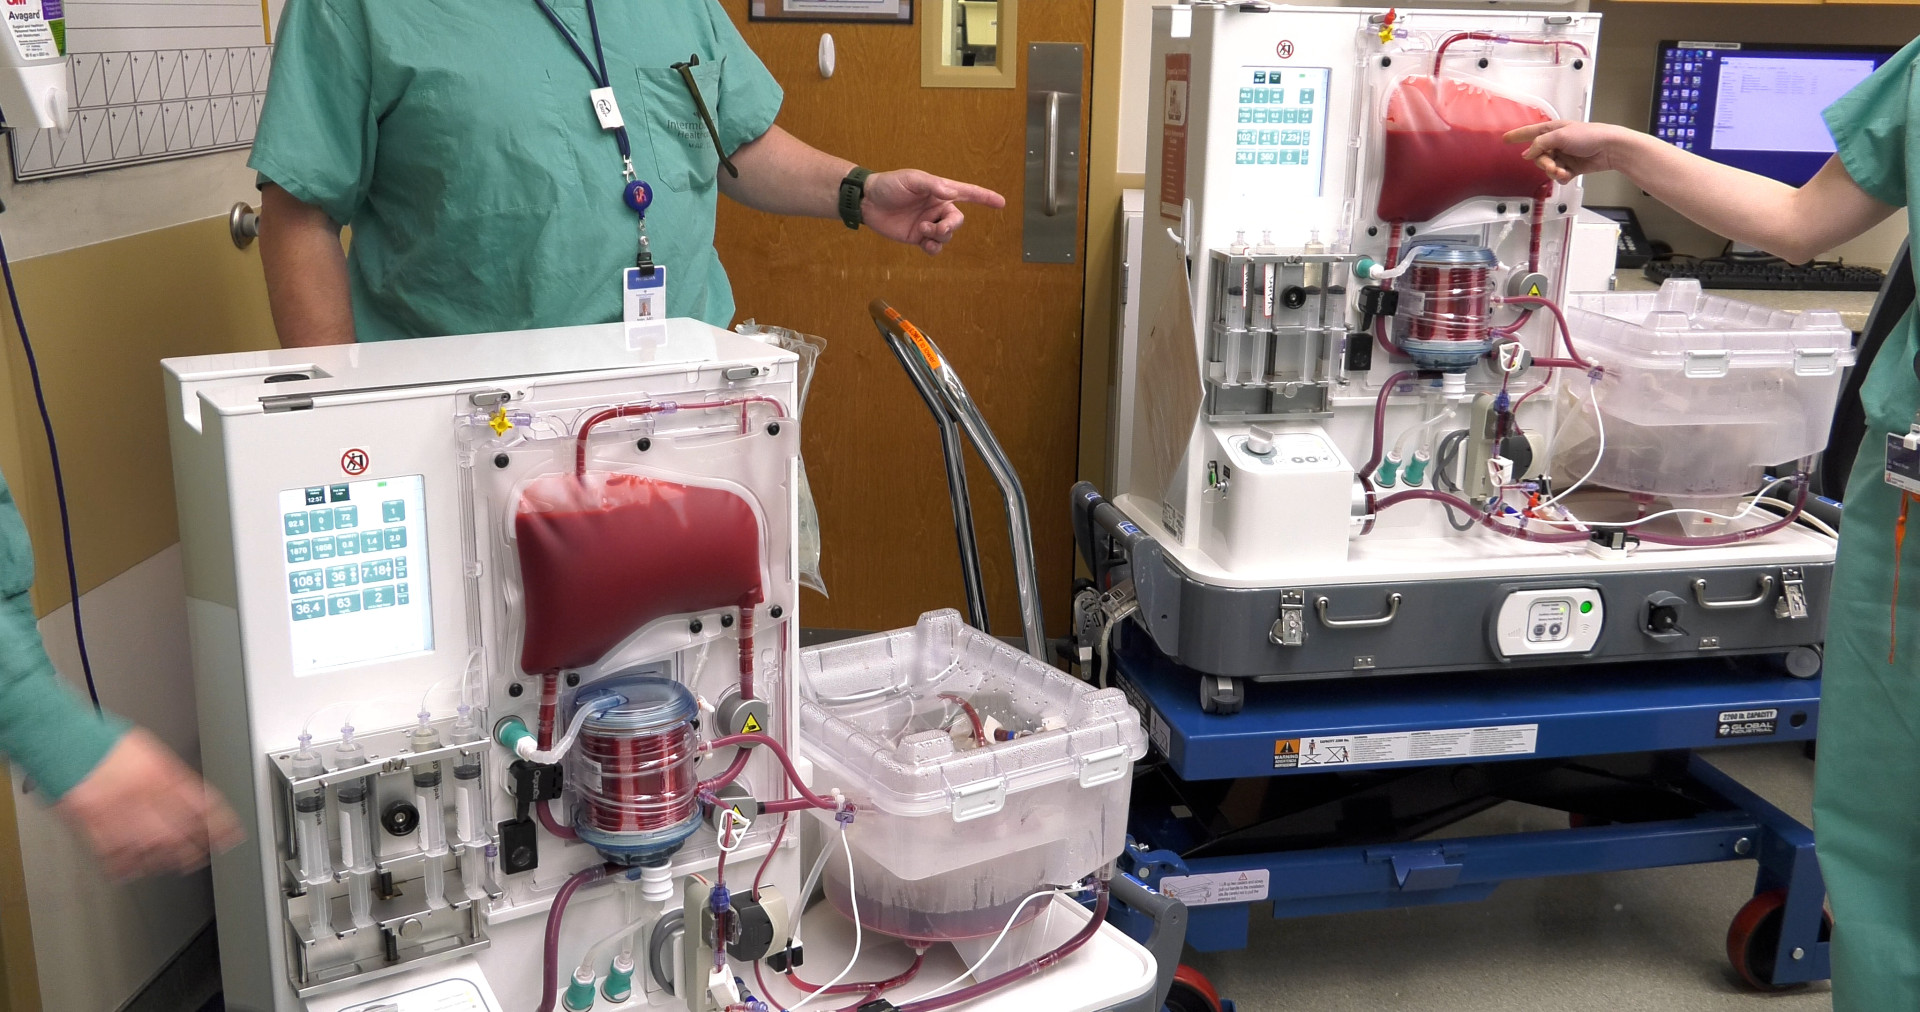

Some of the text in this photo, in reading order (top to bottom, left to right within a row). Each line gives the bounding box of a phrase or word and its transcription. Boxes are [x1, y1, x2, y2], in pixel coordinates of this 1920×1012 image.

[9, 11, 40, 21] Avagard
[293, 574, 313, 587] 108
[331, 570, 346, 582] 36
[362, 565, 385, 578] 7.18
[296, 602, 321, 615] 36.4
[336, 597, 351, 609] 63
[374, 592, 383, 603] 2
[1722, 712, 1738, 721] 2200
[1746, 711, 1773, 719] CAPACITY
[1731, 722, 1773, 730] GLOBAL
